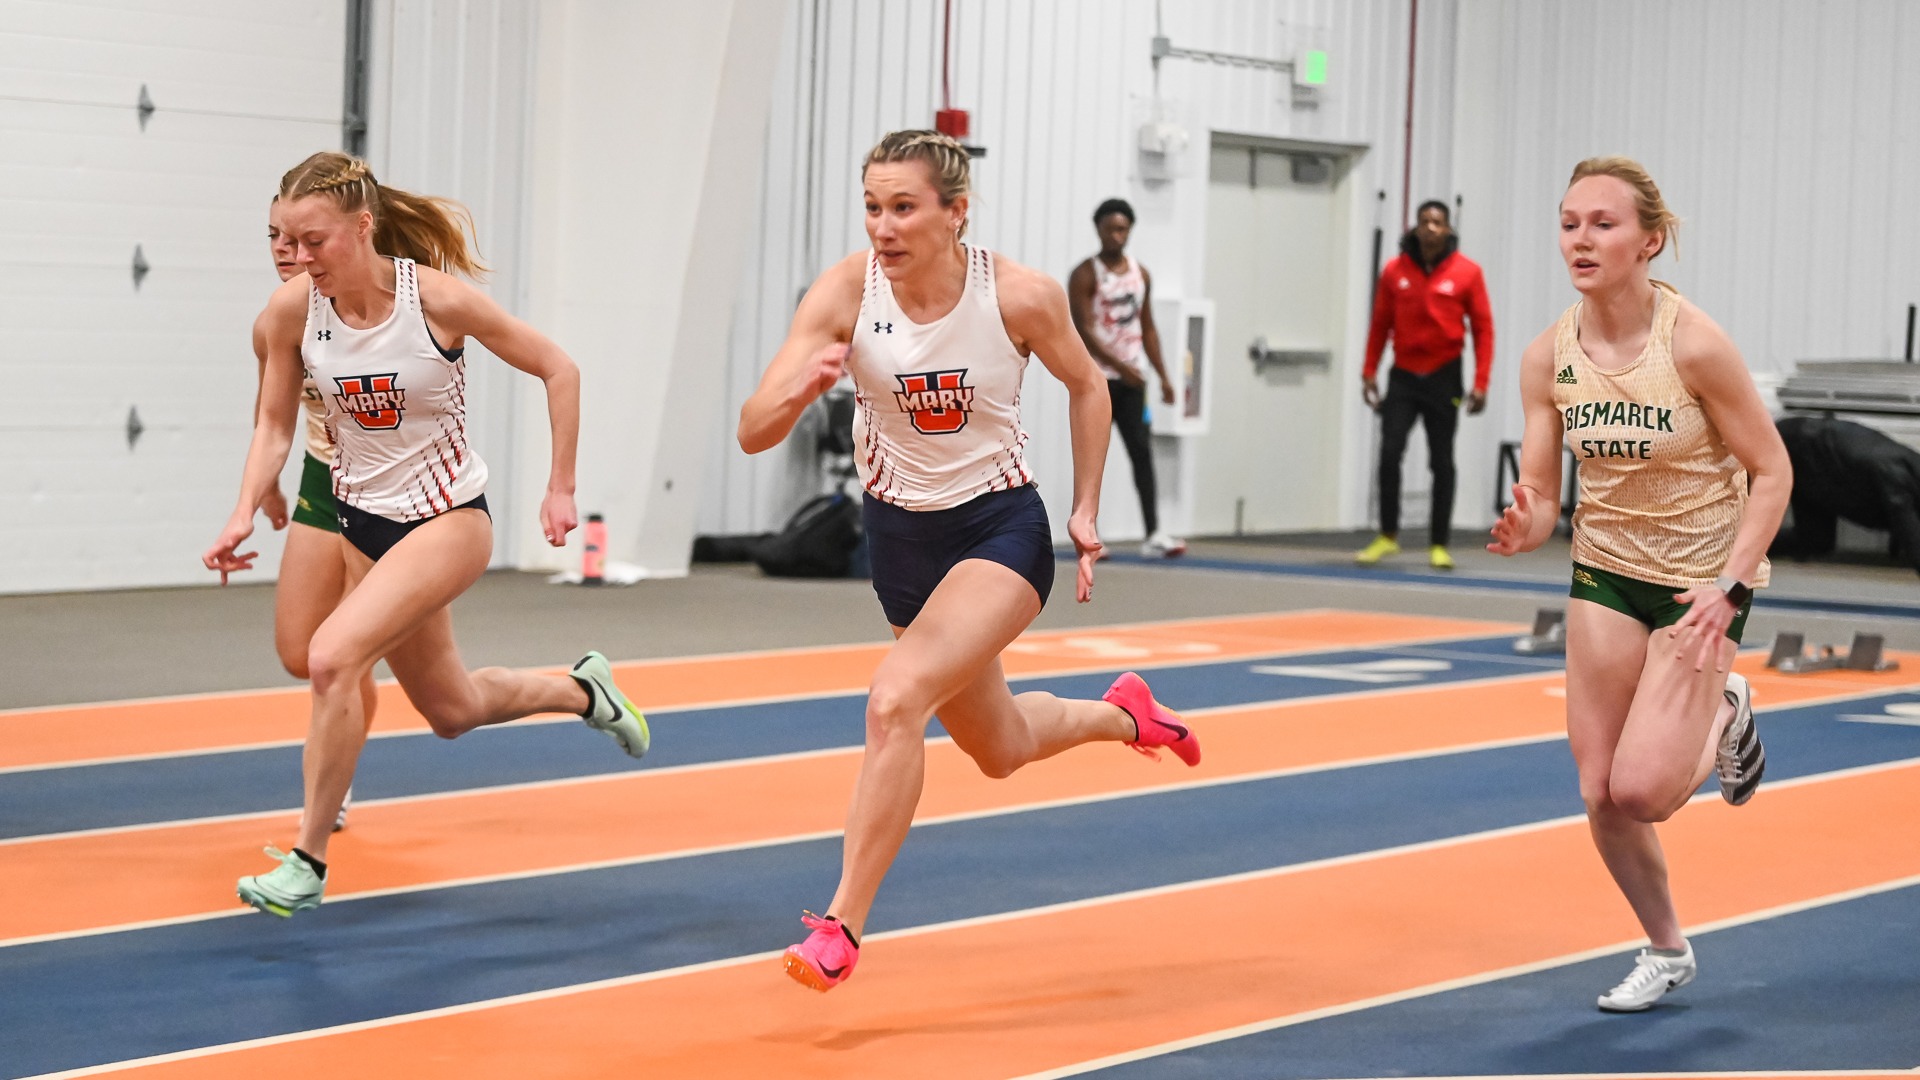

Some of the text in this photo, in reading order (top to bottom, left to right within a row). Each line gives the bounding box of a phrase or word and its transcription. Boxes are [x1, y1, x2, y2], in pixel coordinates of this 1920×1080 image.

[334, 389, 405, 413] MARY
[893, 387, 974, 412] MARY
[1565, 401, 1673, 432] BISMARCK
[1581, 440, 1651, 459] STATE
